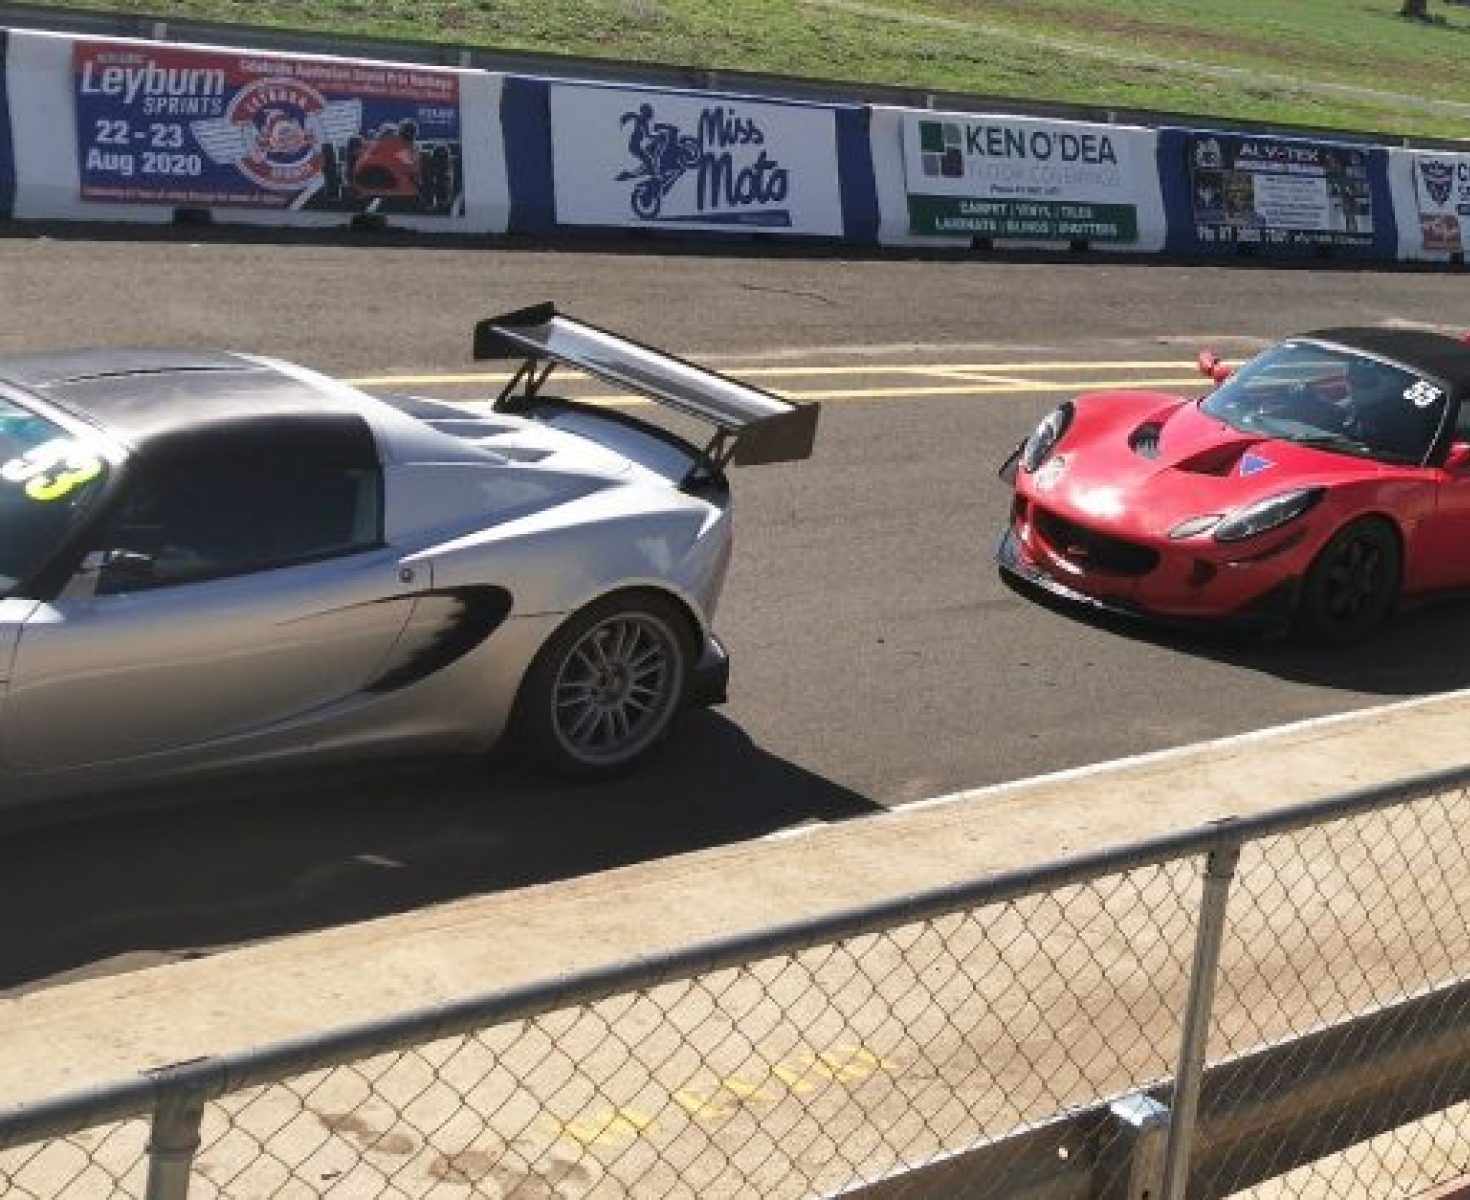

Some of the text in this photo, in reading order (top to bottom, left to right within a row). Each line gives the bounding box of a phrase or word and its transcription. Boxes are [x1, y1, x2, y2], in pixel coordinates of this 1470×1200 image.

[80, 60, 226, 104] Leyburn
[143, 97, 222, 115] SPRINTS
[95, 120, 129, 144] 22
[149, 123, 184, 147] 23
[700, 105, 765, 147] Miss
[966, 124, 1118, 165] KEN O'DEA
[86, 149, 203, 176] Aug 2020
[700, 149, 789, 209] Moto
[1403, 380, 1444, 408] 55
